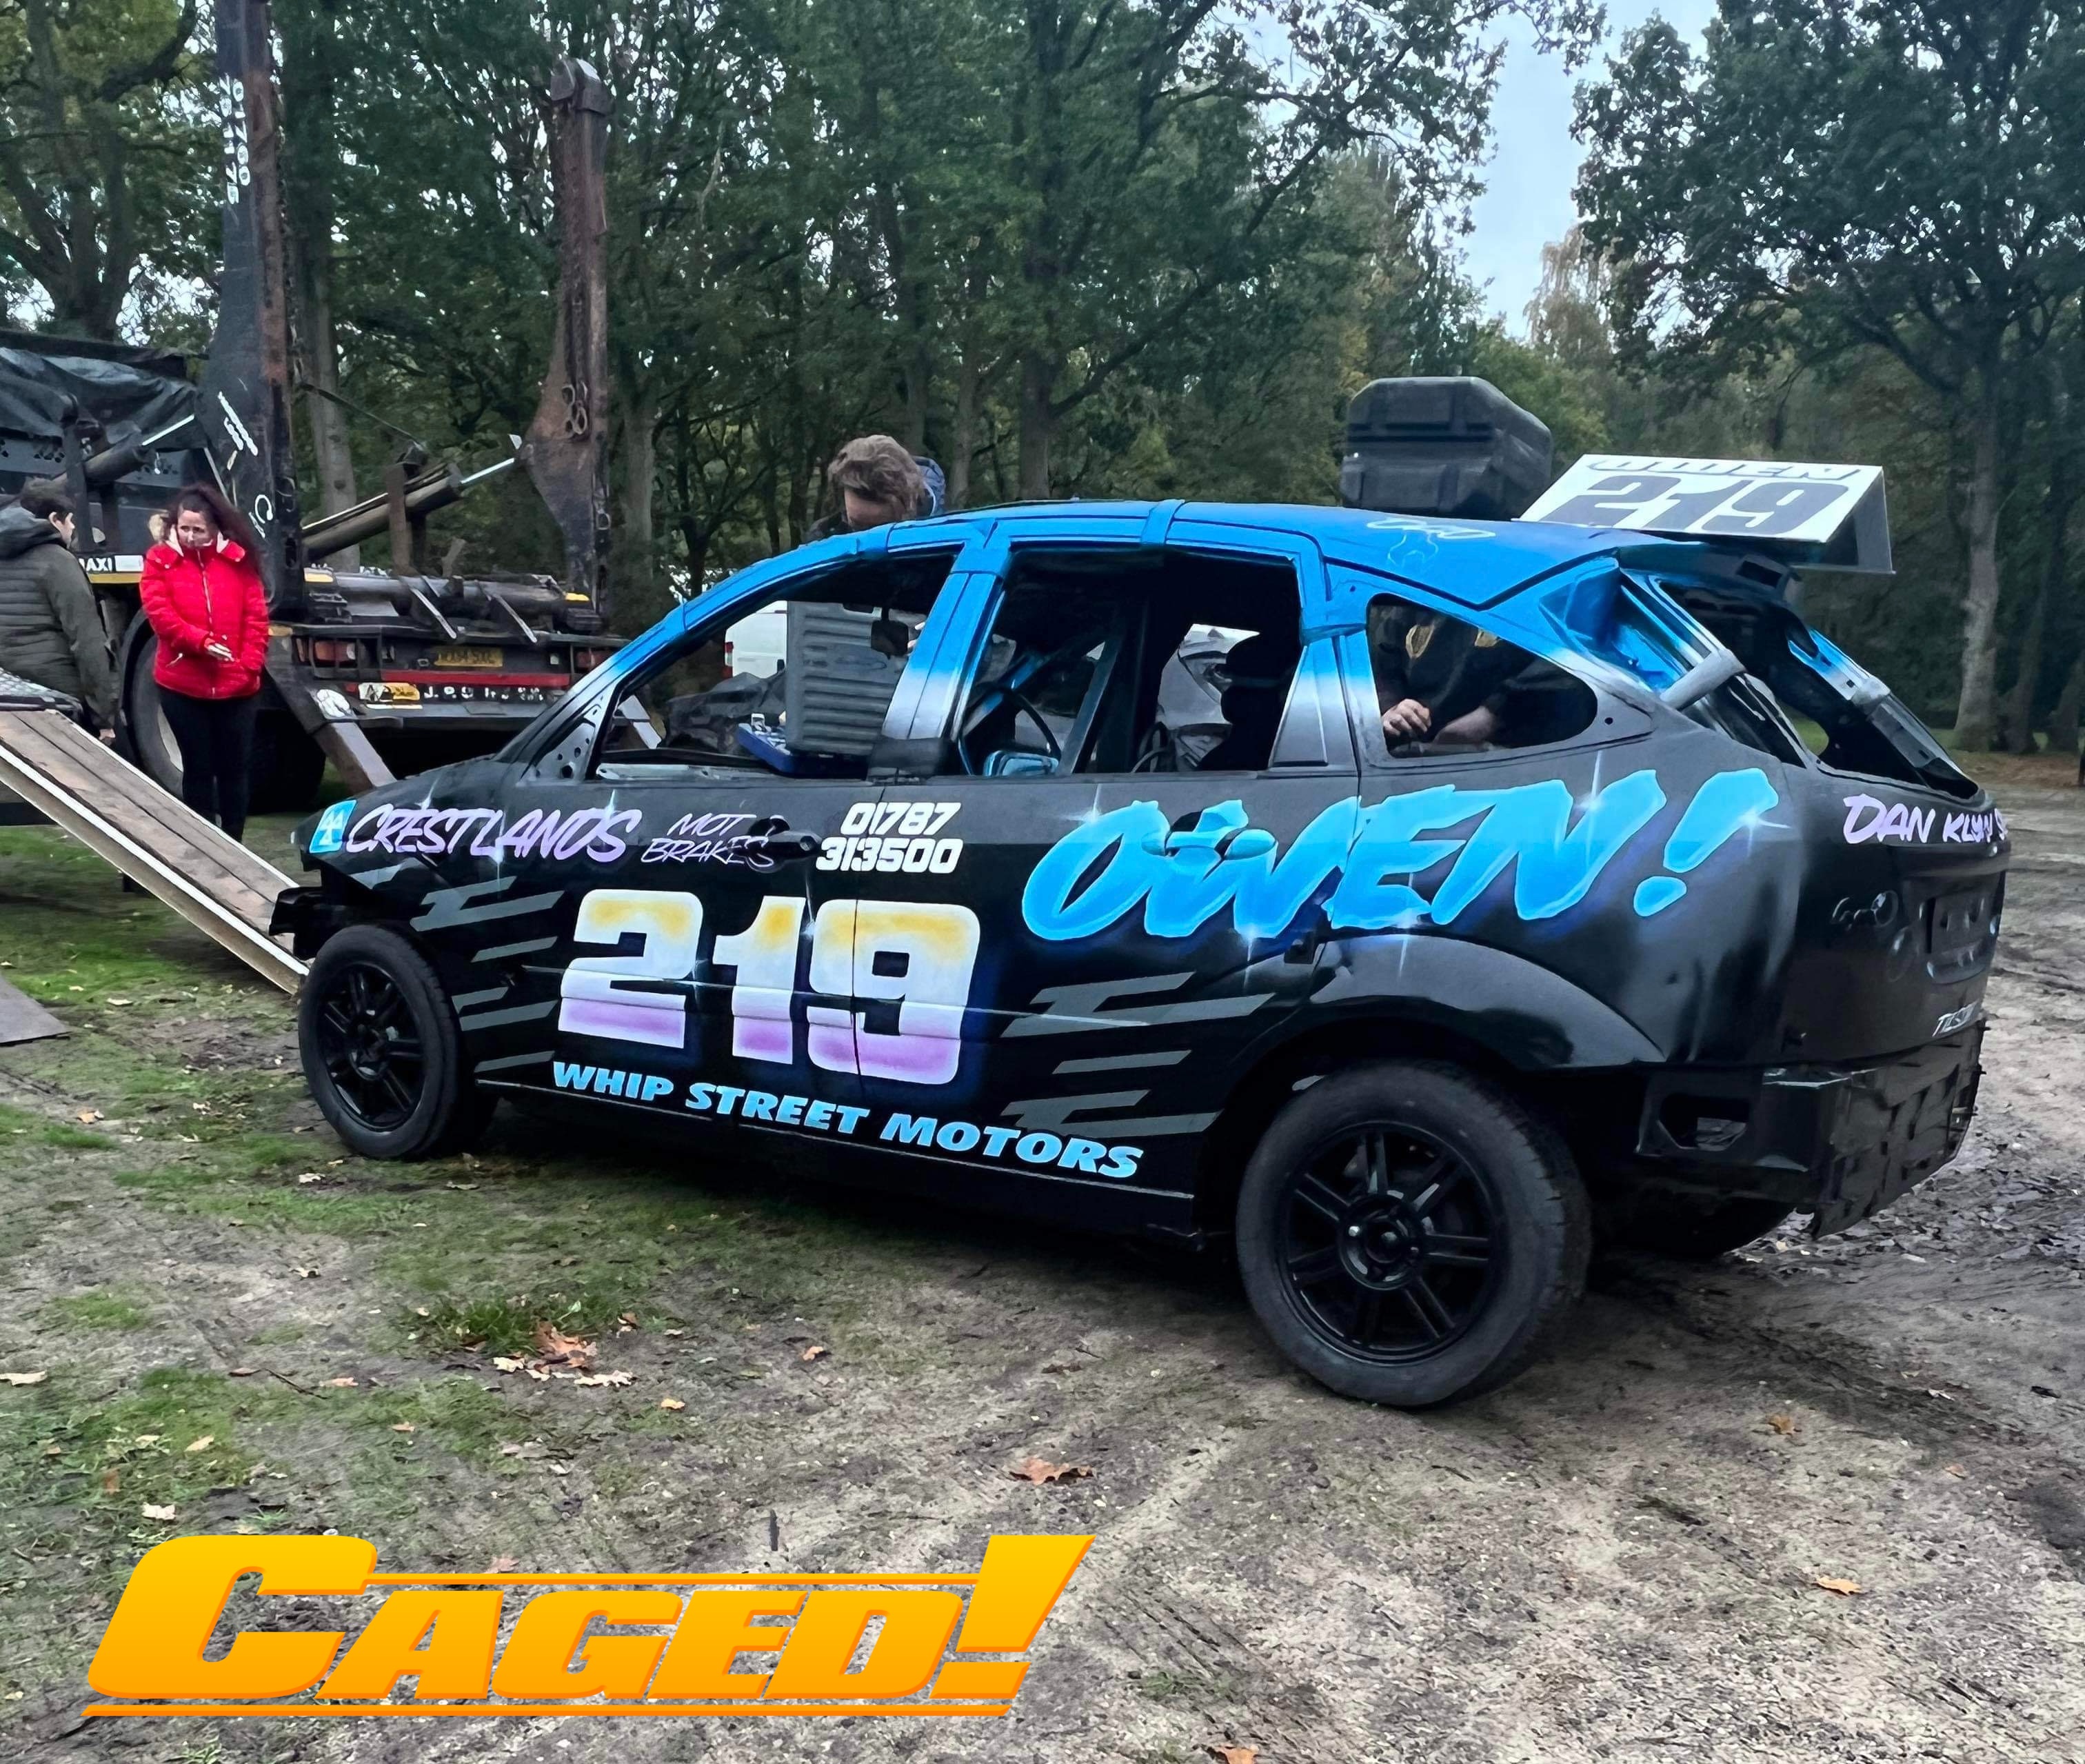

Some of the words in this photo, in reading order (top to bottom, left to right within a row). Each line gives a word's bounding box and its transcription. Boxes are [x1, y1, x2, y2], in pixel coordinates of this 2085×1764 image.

[1539, 474, 1849, 535] 219
[346, 803, 643, 863] CRESTLANDS
[666, 812, 756, 836] MOT
[840, 802, 962, 836] 01787
[1842, 793, 1936, 844] DAN
[641, 834, 774, 868] BRAKES
[816, 836, 963, 874] 313500
[1022, 768, 1780, 941] OWEN!
[557, 888, 981, 1085] 219
[552, 1061, 674, 1102] WHIP
[685, 1082, 871, 1134] STREET
[879, 1113, 1145, 1179] MOTORS
